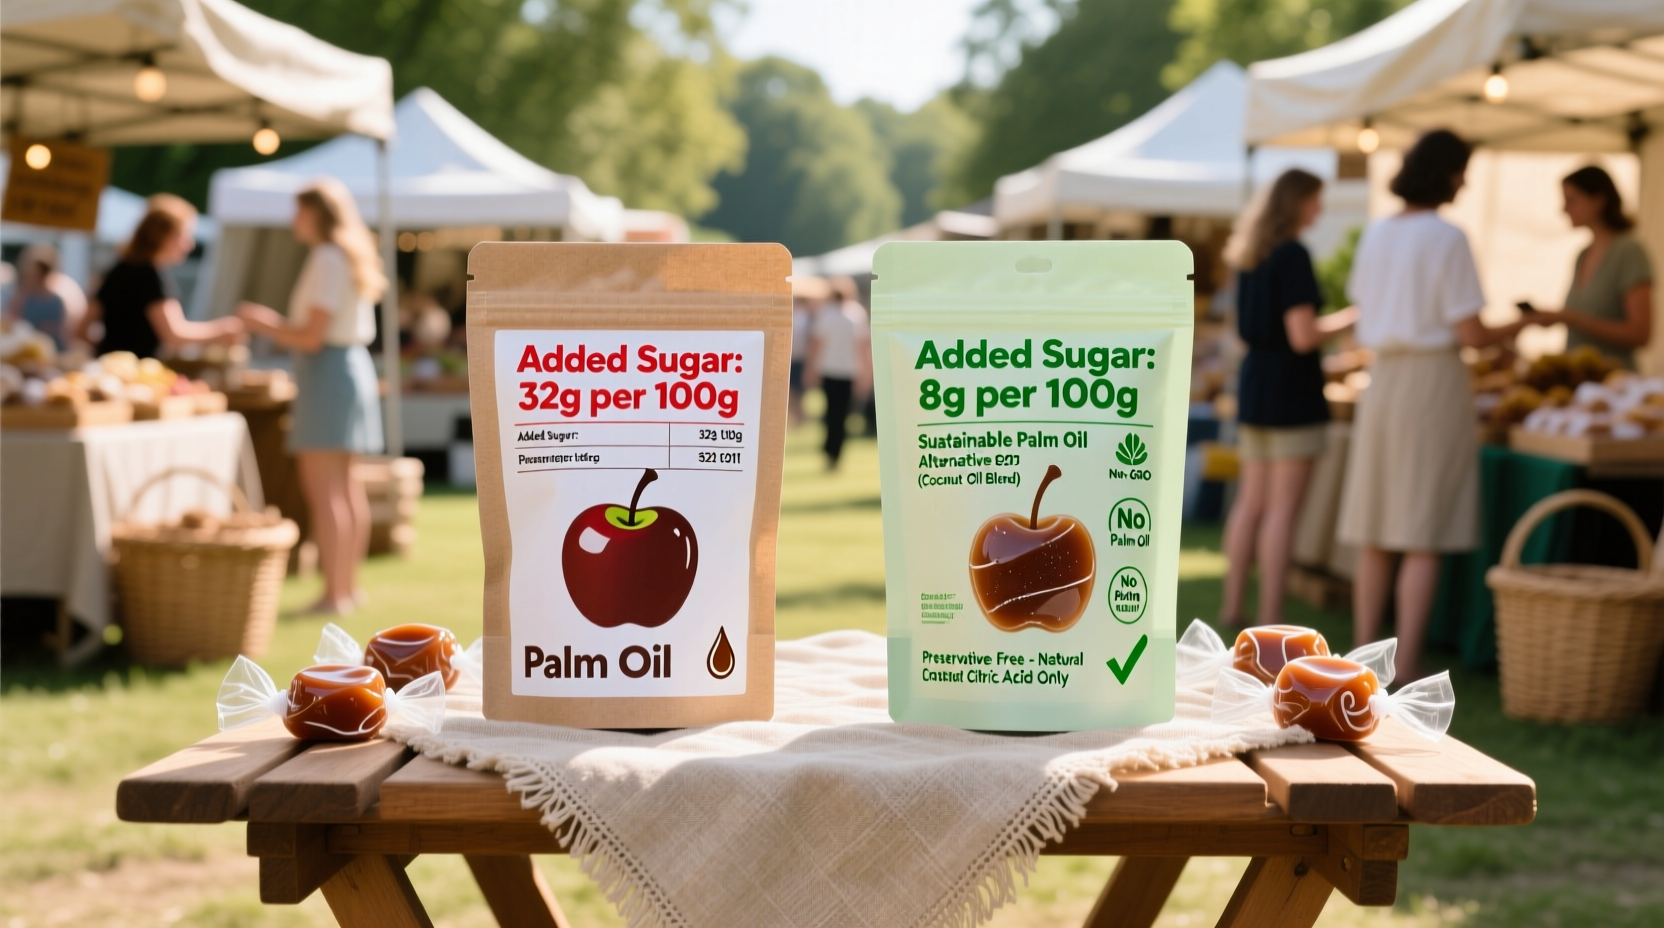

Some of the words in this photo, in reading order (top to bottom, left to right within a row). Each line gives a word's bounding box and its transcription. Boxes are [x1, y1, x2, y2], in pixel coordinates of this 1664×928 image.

[517, 344, 628, 374] Added
[636, 344, 743, 379] Sugar:
[915, 339, 1032, 370] Added
[1042, 339, 1156, 377] Sugar:
[518, 381, 581, 418] 32g
[590, 388, 647, 418] per
[655, 381, 739, 419] 100g
[919, 379, 965, 418] 8g
[976, 387, 1038, 418] per
[1045, 378, 1138, 419] 100g
[1016, 431, 1059, 448] Palm
[1063, 431, 1088, 448] Oil
[1117, 507, 1146, 530] No
[1120, 574, 1138, 588] No
[525, 645, 608, 679] Palm
[618, 643, 672, 679] Oil
[996, 651, 1025, 666] Free
[1038, 651, 1084, 666] Natural
[1001, 669, 1034, 685] Acid
[1037, 669, 1070, 689] Only
